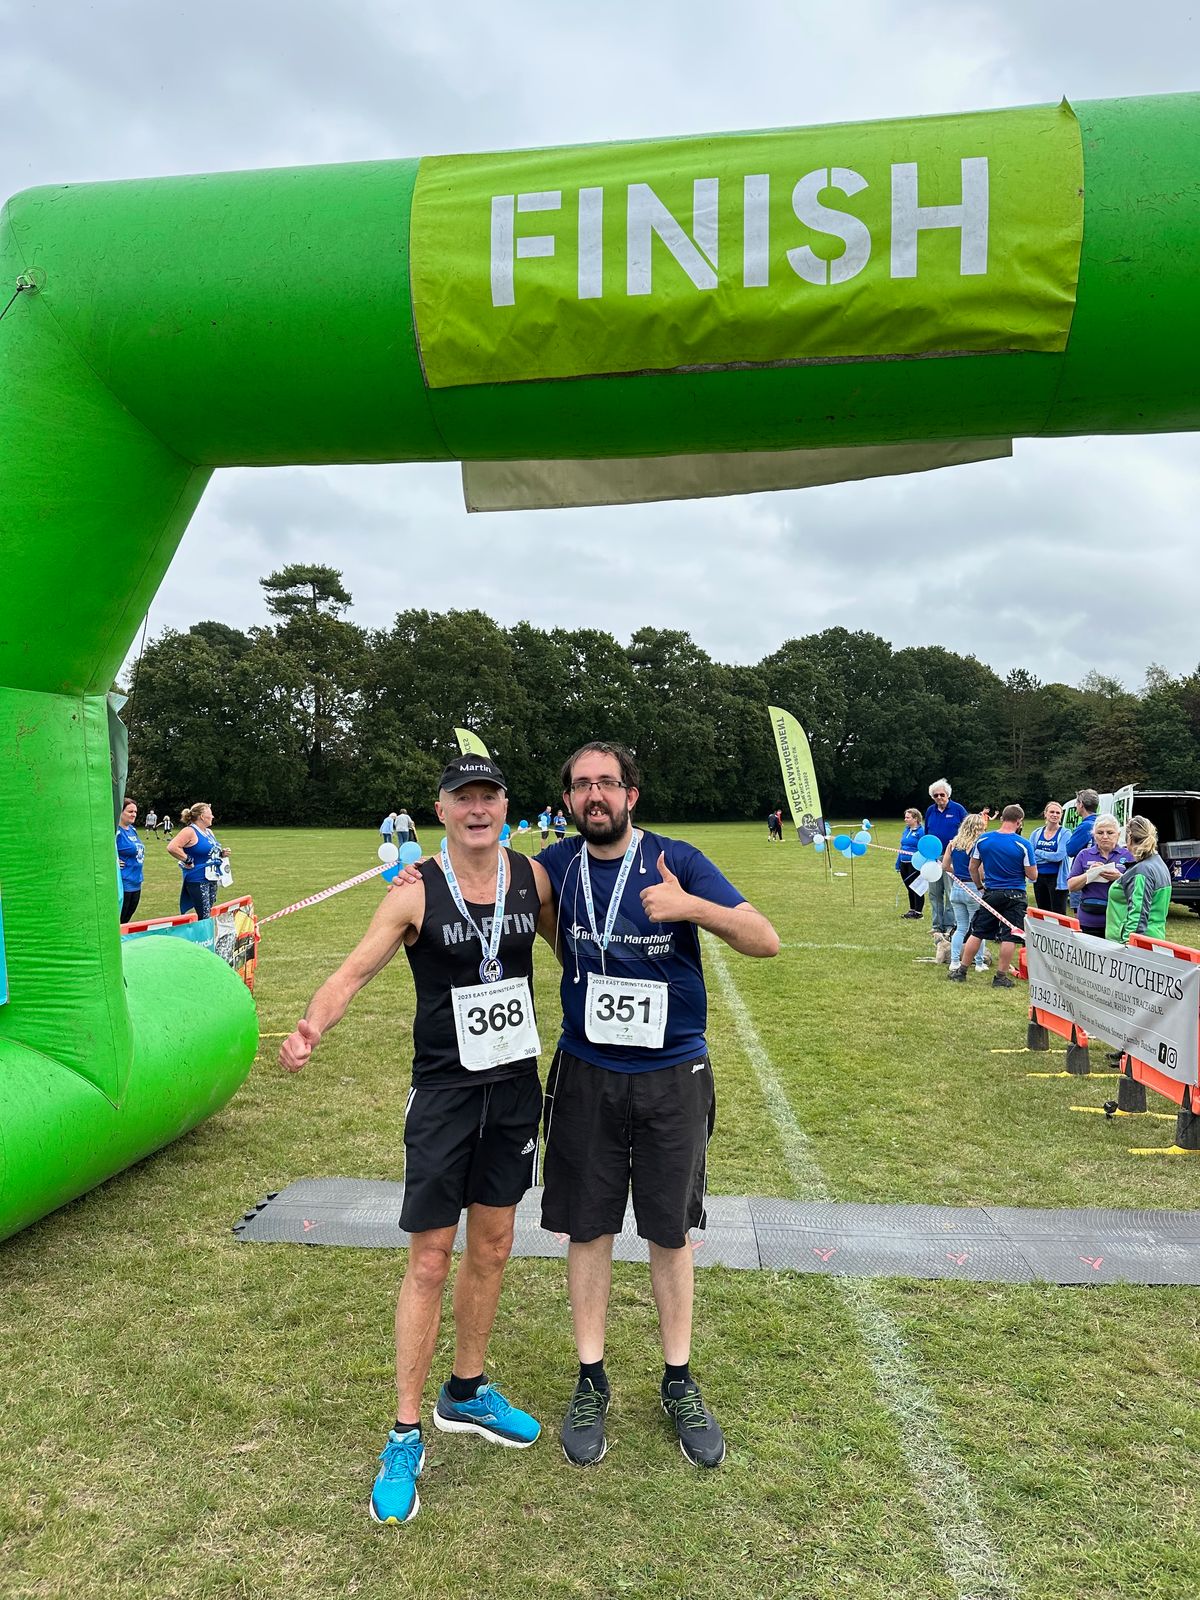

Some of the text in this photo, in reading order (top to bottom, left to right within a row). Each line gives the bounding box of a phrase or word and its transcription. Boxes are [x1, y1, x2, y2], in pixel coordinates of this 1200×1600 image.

[490, 156, 989, 307] FINISH
[460, 764, 492, 774] Martin
[619, 865, 628, 878] Andy
[615, 879, 625, 894] Ripley
[608, 895, 619, 919] Memorial
[442, 912, 535, 946] MARTIN
[623, 934, 672, 944] Marathon
[647, 944, 669, 956] 2019
[1031, 931, 1184, 1001] STONES FAMILY BUTCHERS
[488, 984, 515, 996] GRINSTEAD
[620, 981, 652, 989] GRINSTEAD
[1030, 984, 1051, 1005] 01342
[1114, 990, 1131, 1004] FULLY
[596, 993, 651, 1024] 351
[467, 998, 524, 1036] 368
[524, 1047, 536, 1056] 368
